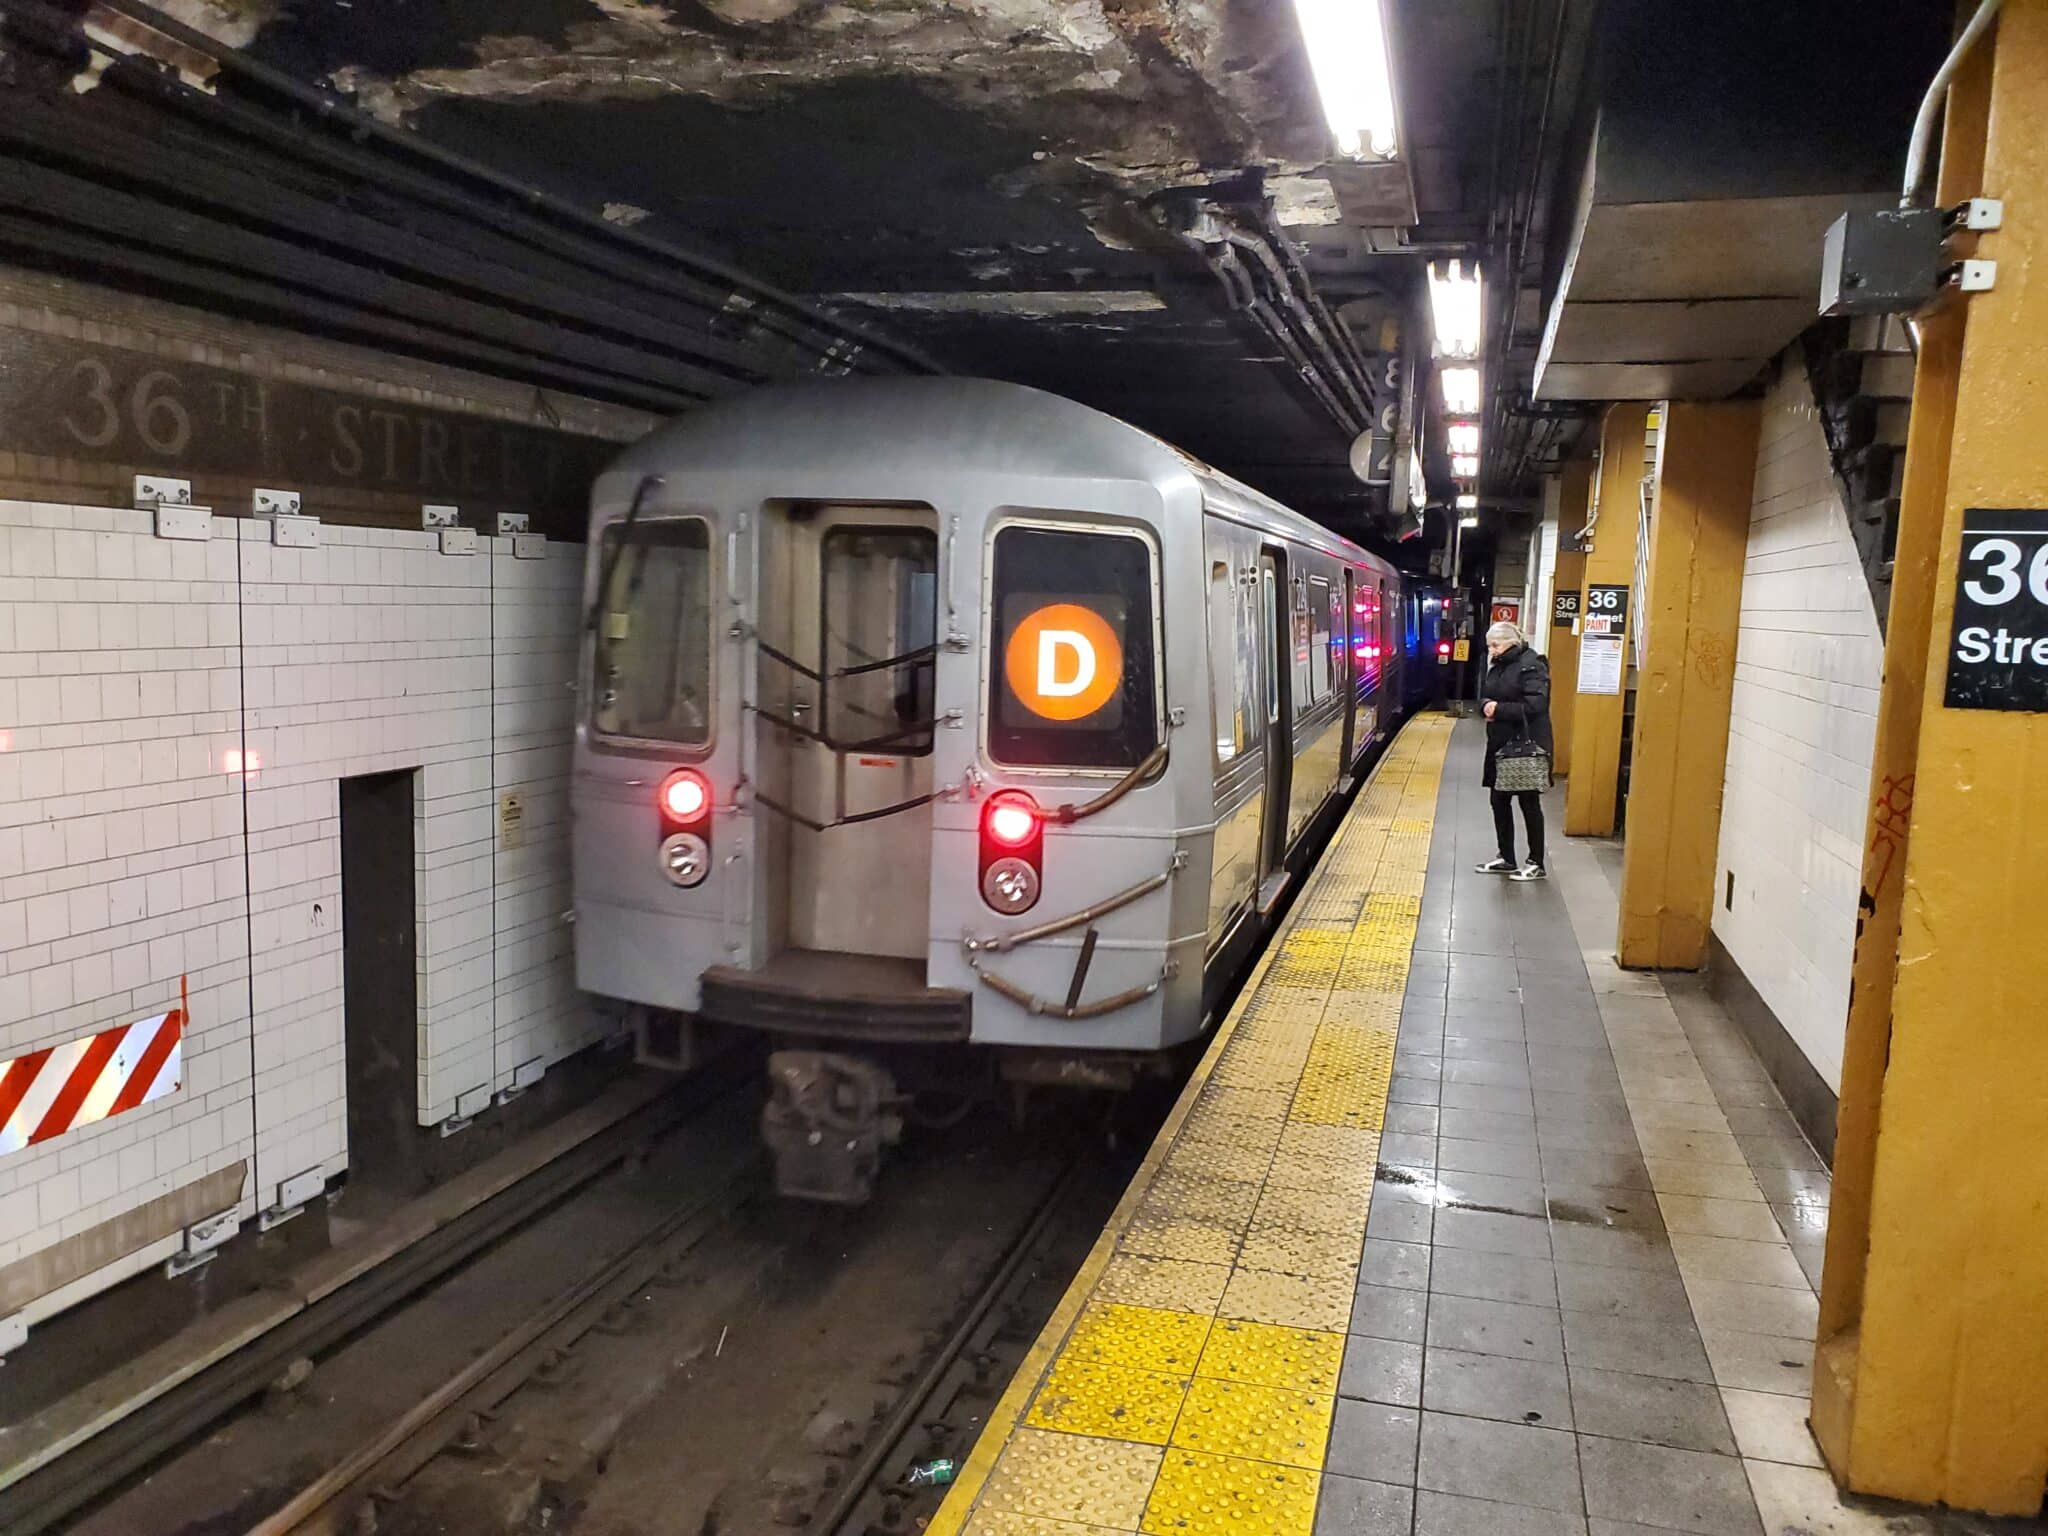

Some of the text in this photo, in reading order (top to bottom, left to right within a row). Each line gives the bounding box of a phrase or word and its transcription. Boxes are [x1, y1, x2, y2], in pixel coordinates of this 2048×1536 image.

[331, 405, 560, 495] STREET
[1555, 597, 1577, 610] 36
[1588, 591, 1618, 609] 36
[1585, 619, 1608, 631] PAINT
[1036, 629, 1097, 697] D
